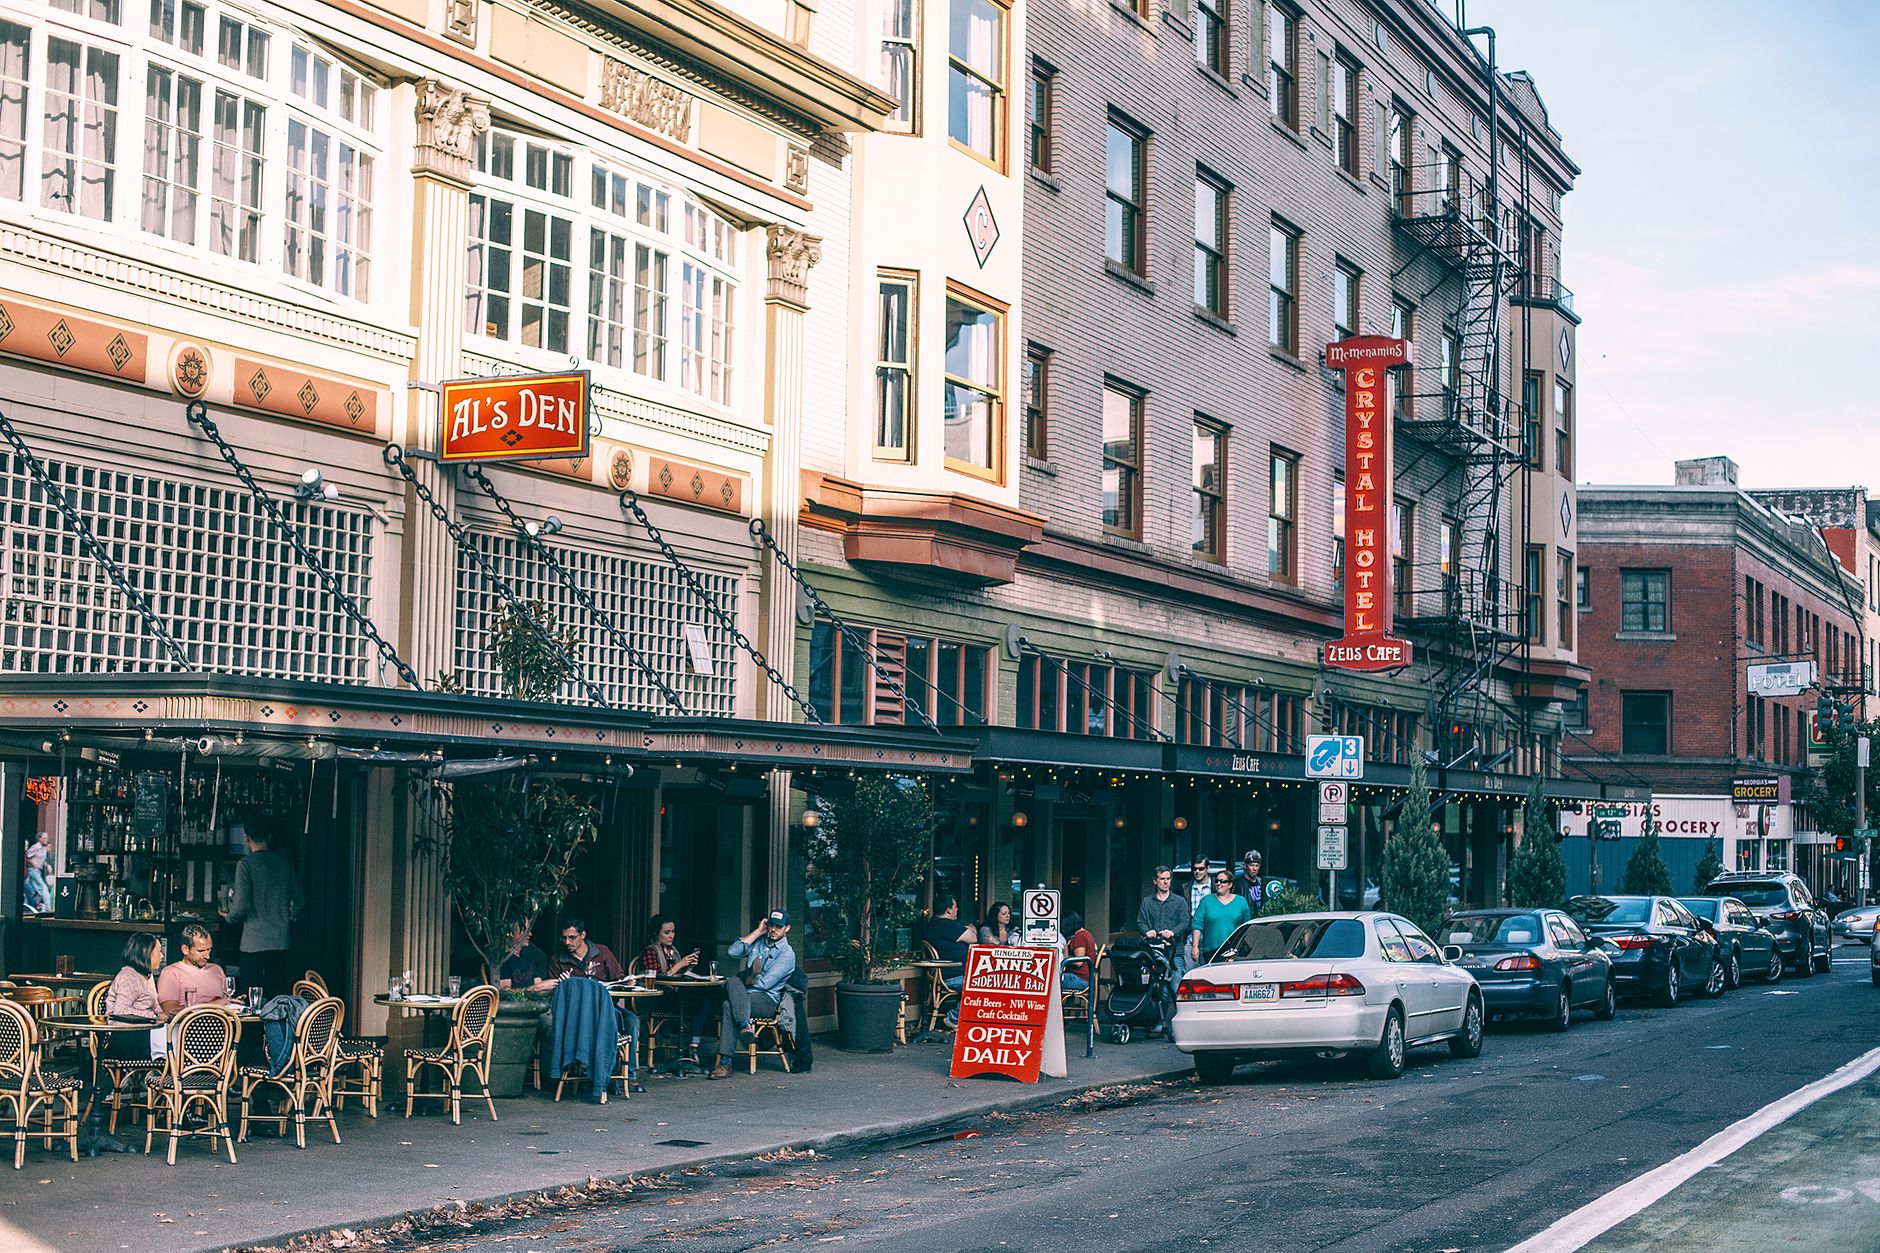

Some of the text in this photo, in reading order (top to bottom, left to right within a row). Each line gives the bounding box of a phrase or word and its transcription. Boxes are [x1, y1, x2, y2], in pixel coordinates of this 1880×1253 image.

[450, 388, 576, 442] AL'S DEN
[1354, 368, 1376, 630] CRYSTAL HOTEL
[1328, 644, 1401, 661] ZEUS CAFE
[1752, 671, 1807, 689] HOTEL
[1345, 738, 1356, 755] 3
[1734, 786, 1778, 798] GROCERY
[994, 949, 1033, 958] RINGLERS
[972, 955, 1049, 981] ANNEX
[971, 973, 1045, 991] SIDEWALK BAR
[1244, 989, 1276, 999] AAH6627
[963, 997, 1045, 1011] Craft Beers NW Wine
[977, 1009, 1029, 1021] Craft Cocktails
[967, 1026, 1033, 1046] OPEN
[962, 1046, 1032, 1066] DAILY
